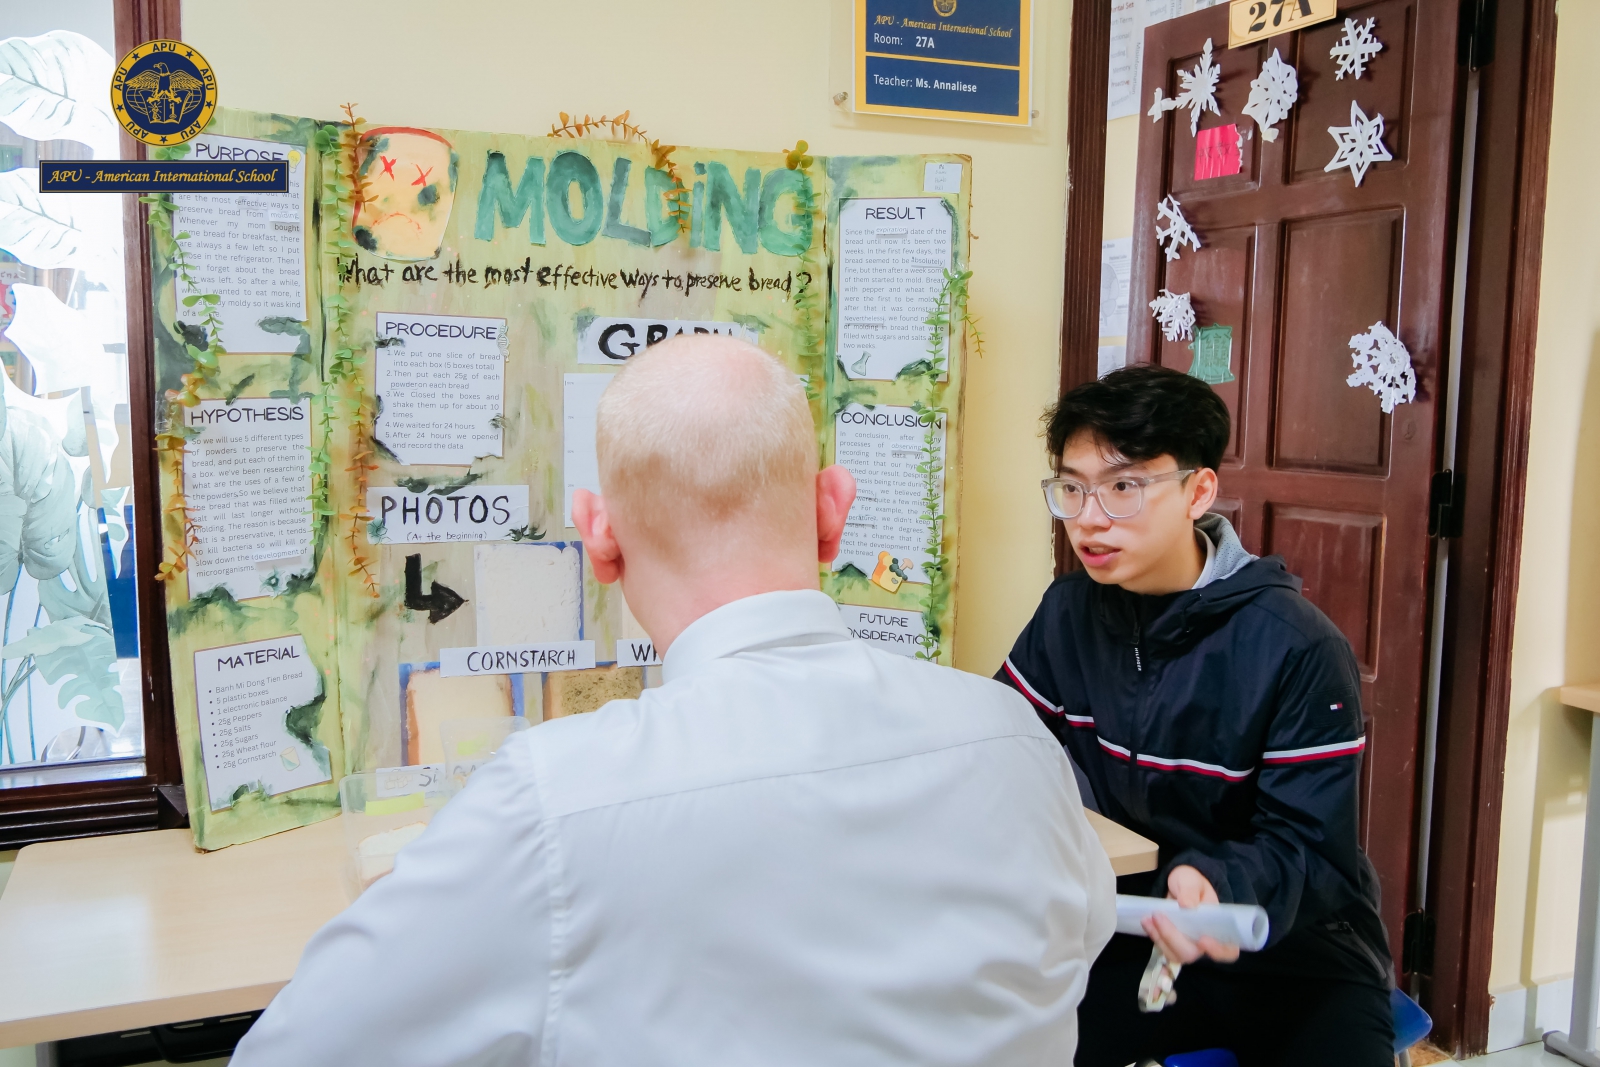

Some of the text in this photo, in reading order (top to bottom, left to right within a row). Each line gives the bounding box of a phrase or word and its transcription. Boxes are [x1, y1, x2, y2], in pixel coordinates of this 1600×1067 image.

[1248, 0, 1314, 34] 27A
[874, 15, 895, 26] APU
[901, 18, 936, 30] American
[938, 22, 987, 36] International
[988, 28, 1013, 38] School
[874, 33, 935, 48] Room: 27A
[1132, 42, 1140, 94] Misinformation
[874, 74, 977, 92] Teacher: Ms. Annaliese
[865, 207, 926, 220] RESULT
[179, 217, 218, 226] Whenever
[274, 224, 299, 232] bought
[196, 241, 222, 249] always
[402, 264, 438, 286] are
[442, 259, 478, 286] the
[485, 257, 534, 289] most
[536, 264, 618, 290] effective
[385, 322, 497, 340] PROCEDURE
[191, 407, 304, 425] HYPOTHESIS
[263, 465, 304, 473] researching
[381, 495, 510, 526] PHOTOS
[427, 532, 441, 541] the
[860, 613, 908, 627] FUTURE
[218, 646, 300, 671] MATERIAL
[466, 650, 576, 672] CORNSTARCH
[216, 685, 234, 693] Banh
[282, 671, 302, 680] Bread
[223, 694, 246, 704] plastic
[248, 689, 268, 698] boxes
[223, 701, 259, 714] electronic
[261, 696, 288, 706] balance
[218, 712, 262, 726] 25g Peppers
[234, 724, 251, 733] Salts
[221, 734, 258, 747] 25g Sugars
[236, 746, 258, 754] Wheat
[260, 740, 276, 749] flour
[223, 751, 276, 768] 25g Cornstarch
